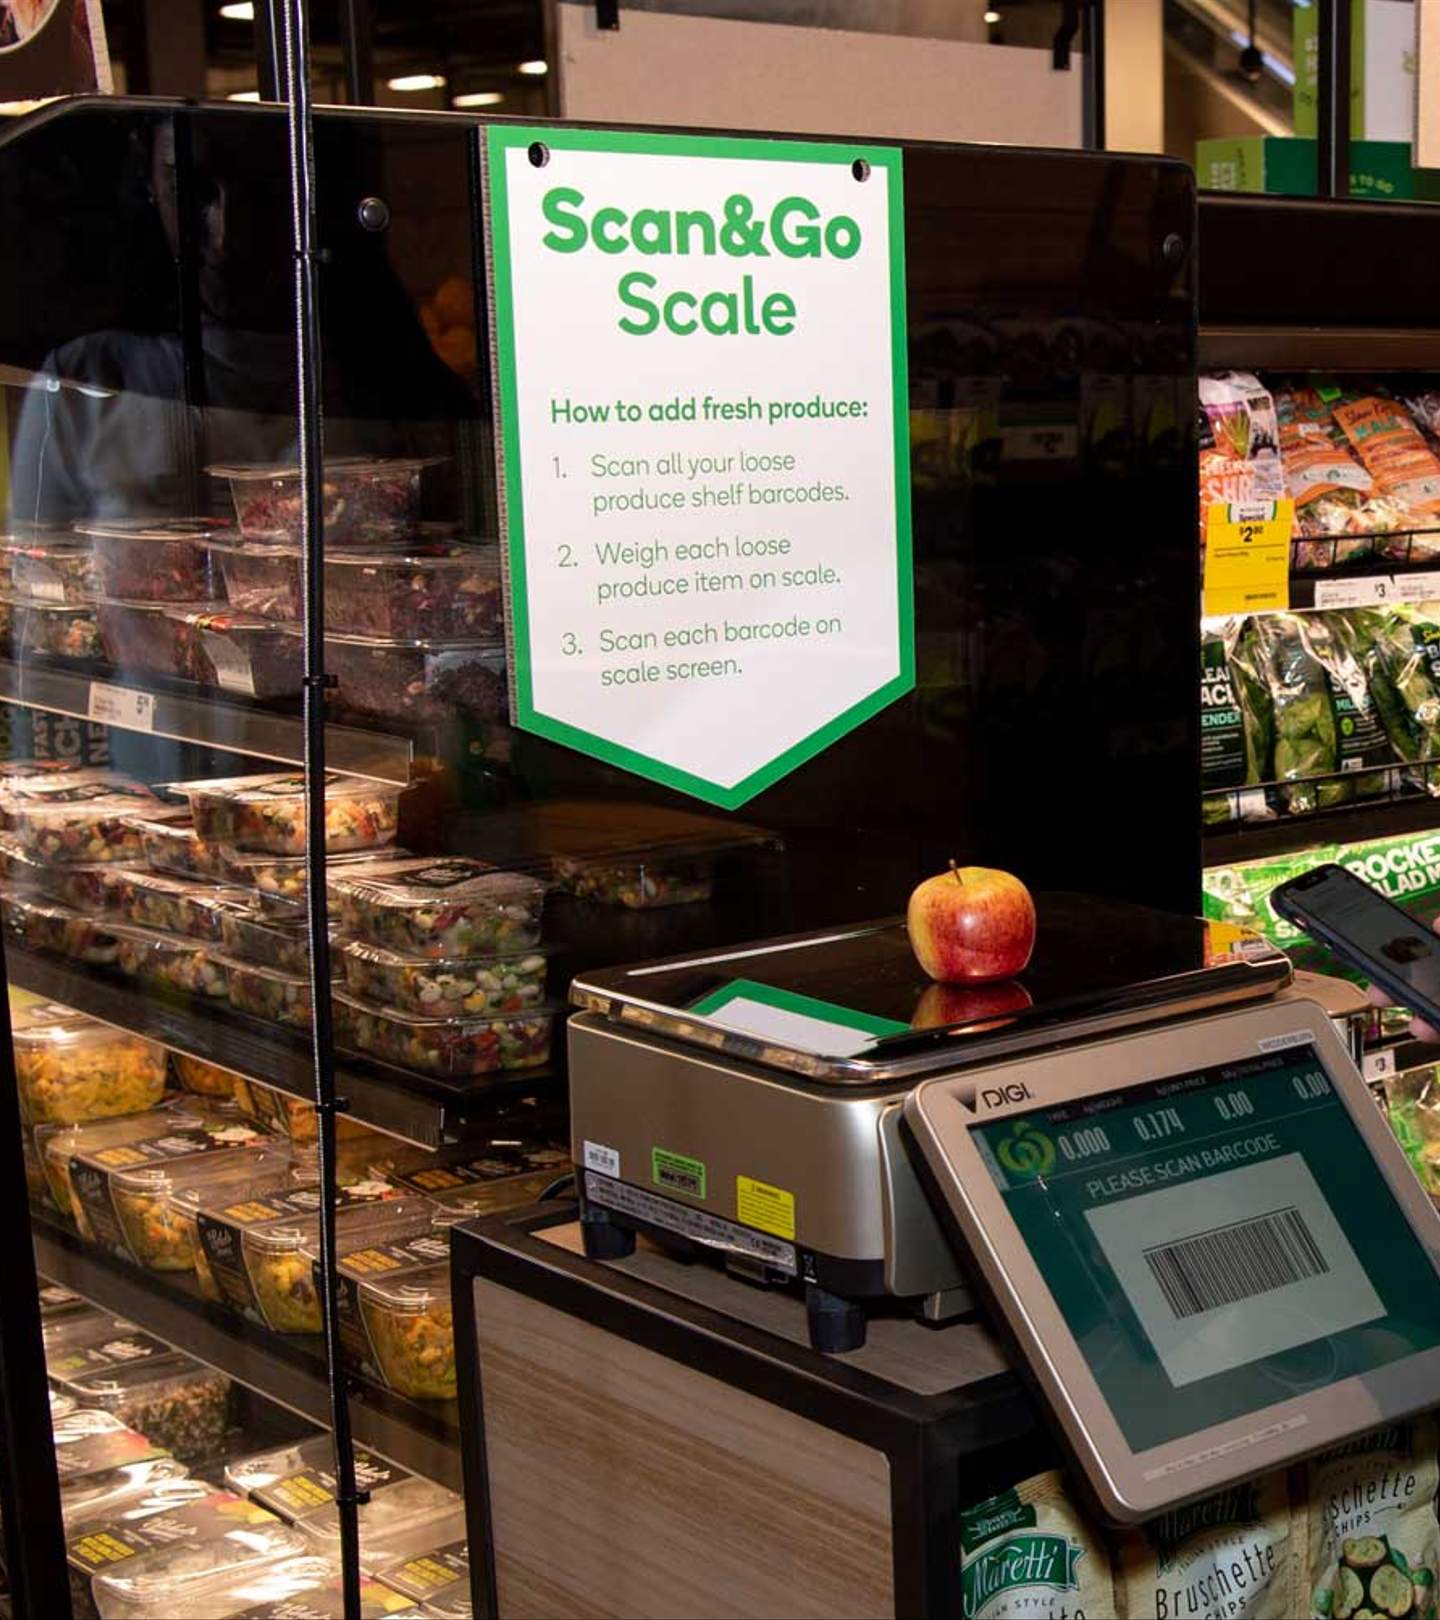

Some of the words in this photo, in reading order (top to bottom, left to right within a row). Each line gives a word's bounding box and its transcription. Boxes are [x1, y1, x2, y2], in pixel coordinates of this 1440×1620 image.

[541, 186, 862, 259] Scan&Go
[617, 271, 797, 336] Scale
[550, 398, 610, 424] How
[615, 399, 643, 422] to
[649, 396, 697, 421] add
[702, 395, 763, 421] fresh
[768, 398, 869, 426] produce:
[552, 456, 567, 479] 1.
[591, 453, 651, 478] Scan
[656, 452, 684, 476] all
[686, 456, 735, 480] your
[740, 451, 796, 472] loose
[593, 489, 686, 517] produce
[691, 483, 744, 509] shelf
[748, 480, 850, 505] barcodes.
[557, 544, 578, 568] 2.
[594, 540, 669, 569] Weigh
[675, 537, 730, 561] each
[735, 535, 792, 557] loose
[597, 575, 690, 605] produce
[694, 571, 744, 593] item
[749, 573, 777, 589] on
[781, 564, 842, 588] scale.
[561, 631, 583, 656] 3.
[600, 629, 657, 653] Scan
[663, 622, 719, 647] each
[723, 614, 811, 642] barcode
[816, 616, 842, 635] on
[601, 660, 661, 686] scale
[666, 657, 743, 681] screen.
[1373, 866, 1428, 899] ALAD
[981, 1082, 1031, 1109] DIGI
[1291, 1071, 1332, 1101] 0.00
[1214, 1090, 1256, 1121] 0.00
[1132, 1108, 1186, 1142] 0.174
[1058, 1126, 1111, 1160] 0.000
[1085, 1166, 1155, 1200] PLEASE
[1154, 1153, 1203, 1181] SCAN
[1200, 1133, 1282, 1168] BARCODE
[1155, 1543, 1277, 1620] Bruschette
[1014, 1596, 1056, 1610] STYLE
